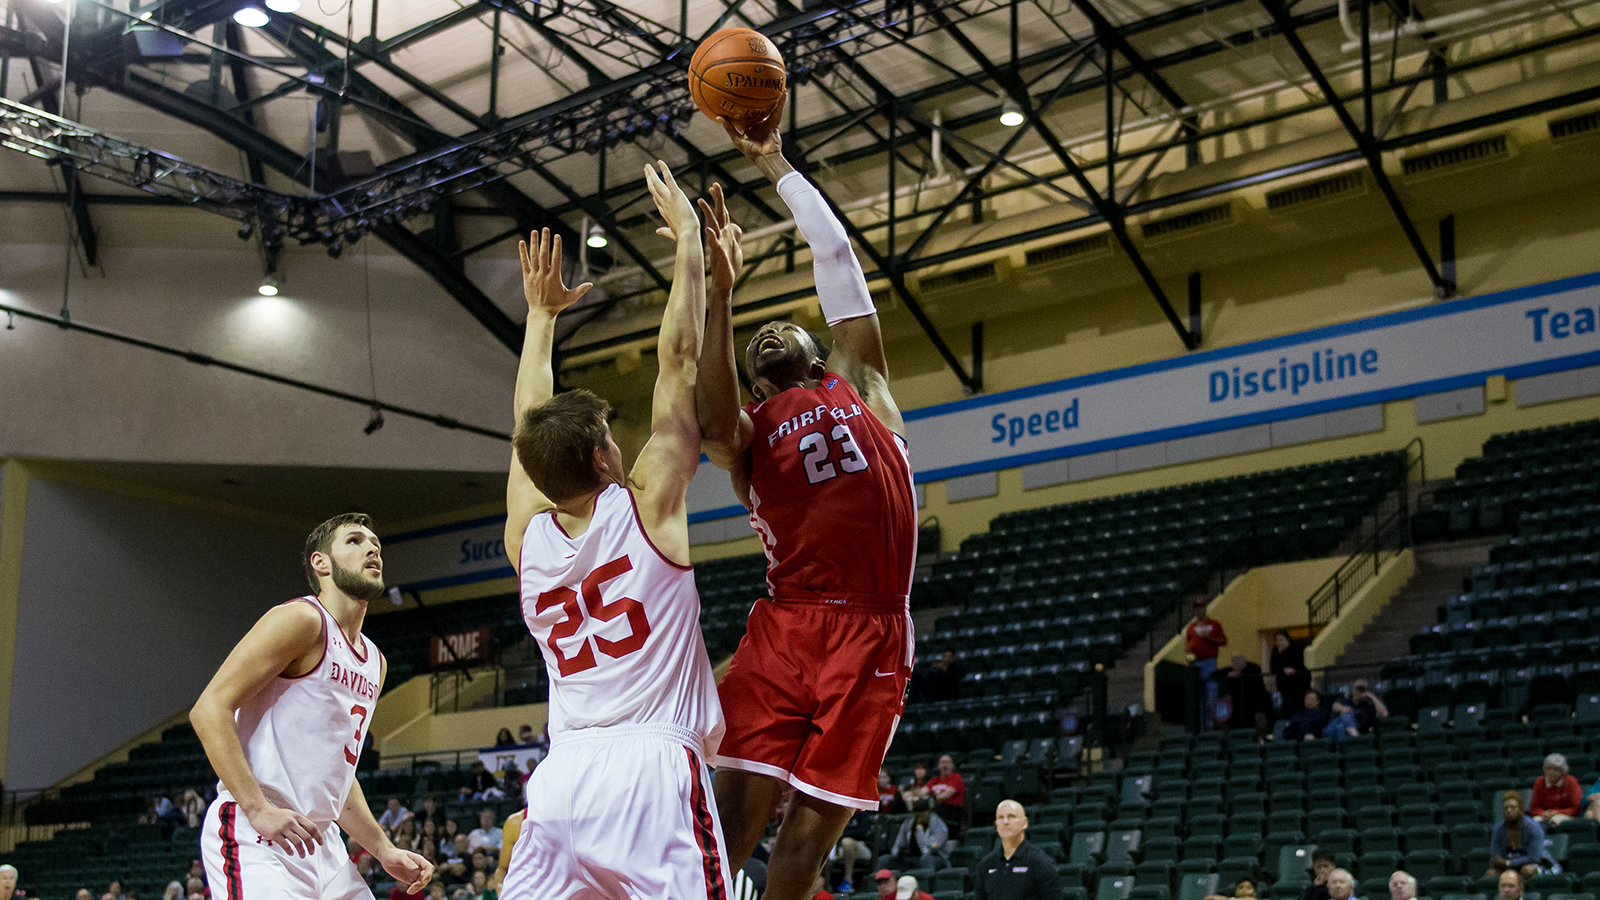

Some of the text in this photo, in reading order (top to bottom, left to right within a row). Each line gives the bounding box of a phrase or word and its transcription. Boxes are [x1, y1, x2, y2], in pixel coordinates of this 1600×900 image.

[725, 72, 784, 93] SPALDING
[1525, 307, 1600, 343] Tea
[1209, 349, 1378, 403] Discipline
[767, 403, 862, 448] FAIRFELD
[991, 398, 1079, 446] Speed
[798, 424, 868, 484] 23
[535, 554, 651, 678] 25
[344, 704, 367, 767] 3
